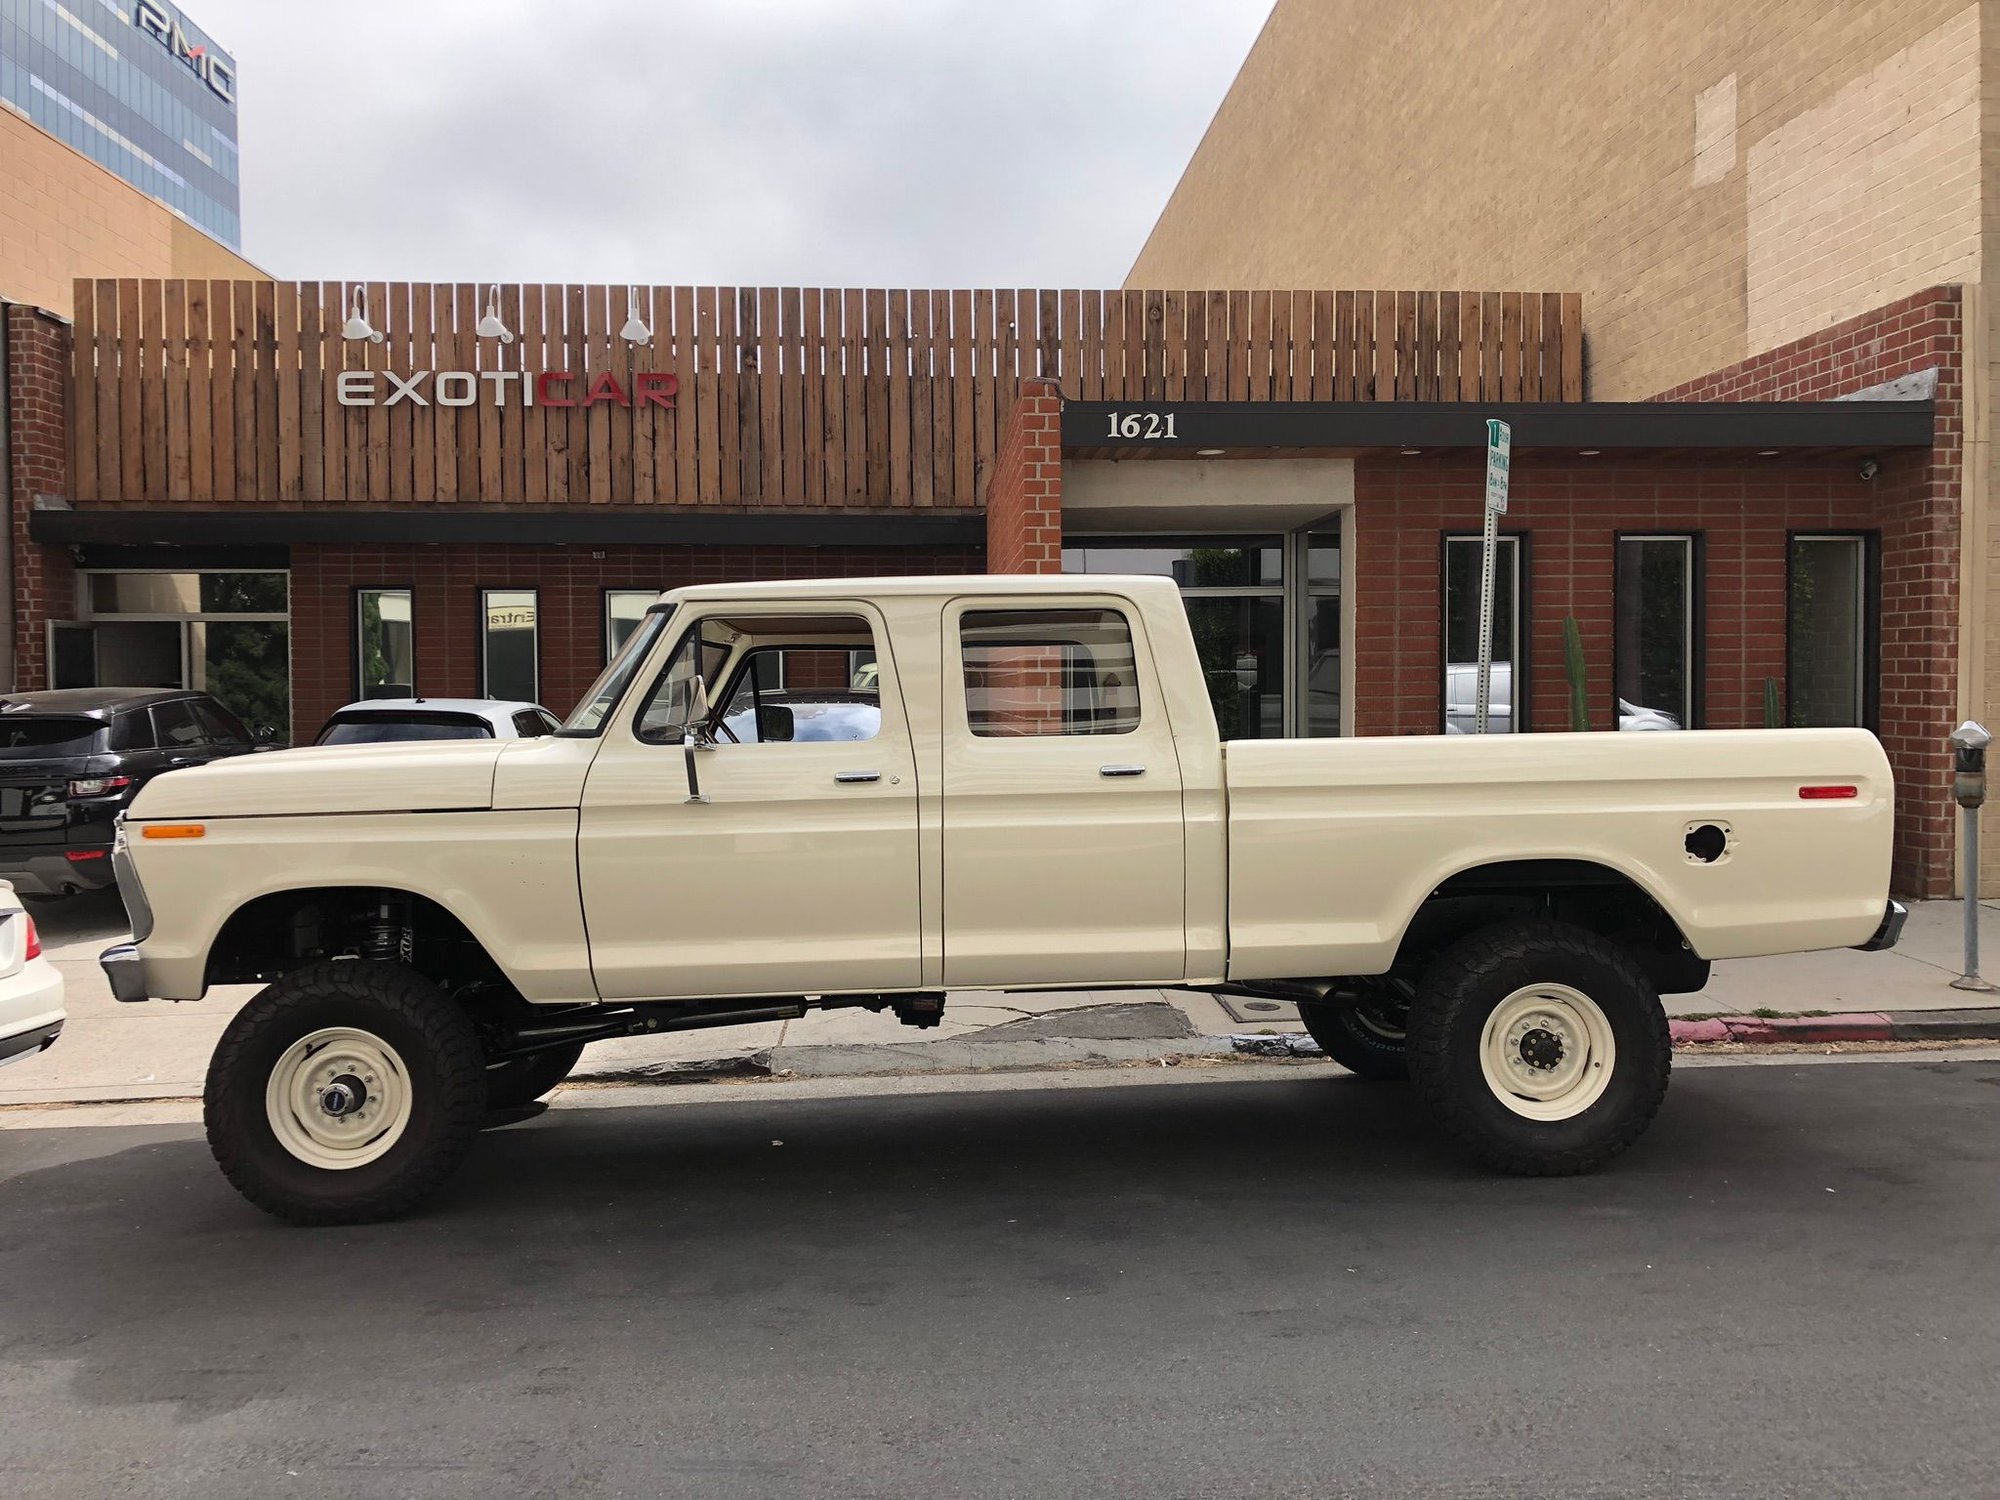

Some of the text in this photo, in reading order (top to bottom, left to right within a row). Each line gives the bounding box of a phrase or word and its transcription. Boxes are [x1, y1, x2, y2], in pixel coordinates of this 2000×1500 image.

[138, 0, 236, 104] PMC
[337, 370, 680, 409] EXOTICAR
[1107, 411, 1178, 439] 1621
